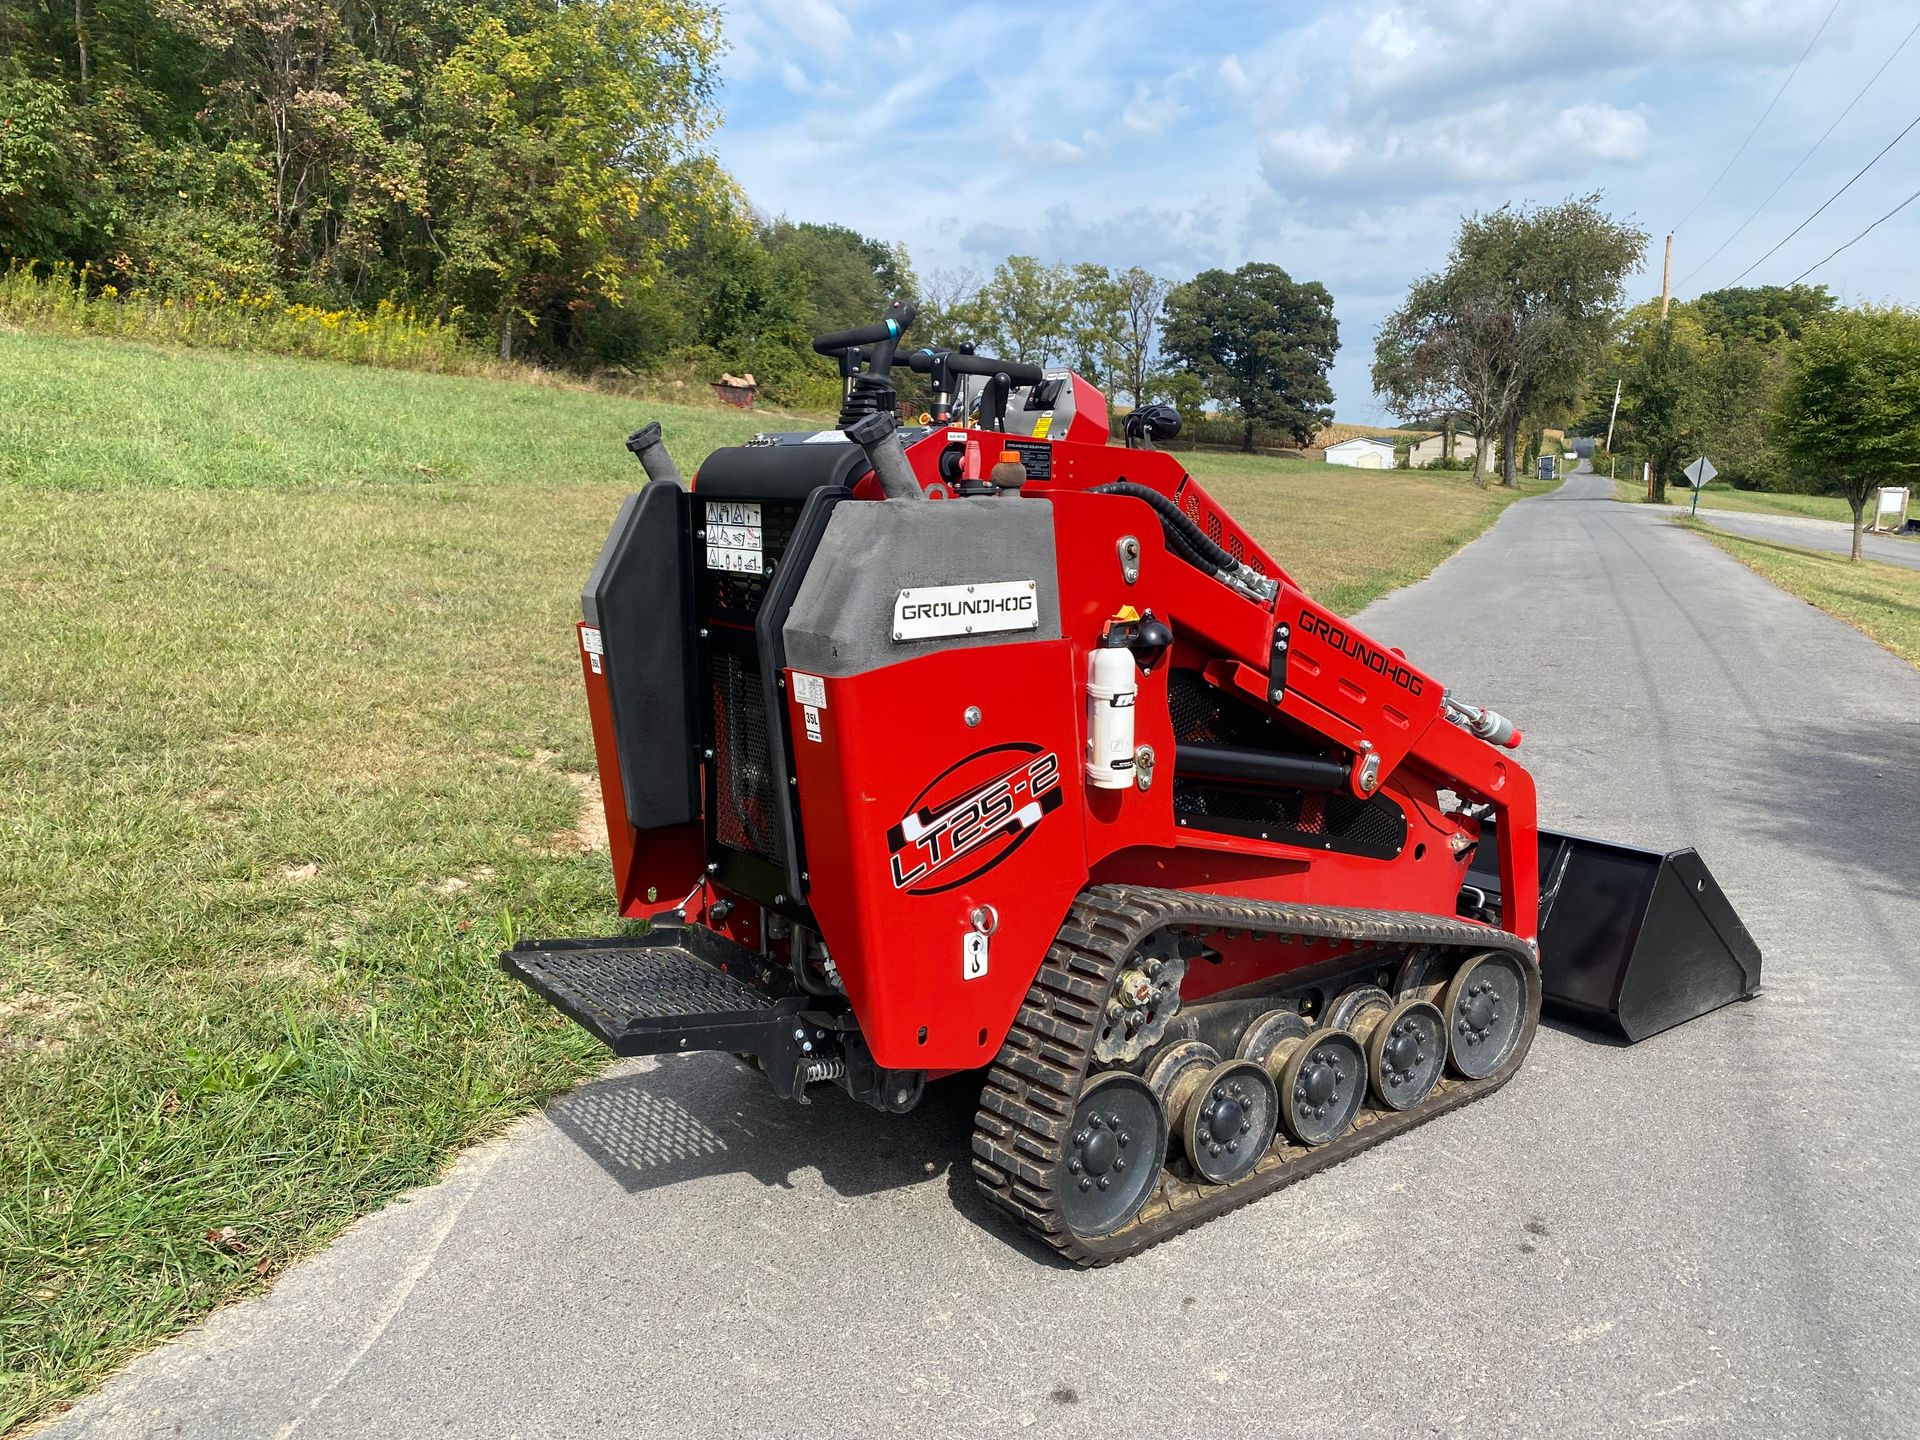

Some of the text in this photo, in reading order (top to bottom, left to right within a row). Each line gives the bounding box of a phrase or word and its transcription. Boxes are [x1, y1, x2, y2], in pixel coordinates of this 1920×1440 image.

[902, 596, 1032, 620] GROUNDHOG
[1298, 609, 1424, 696] GROUNDHOG
[806, 712, 819, 726] 35L
[890, 752, 1060, 889] LT25-2
